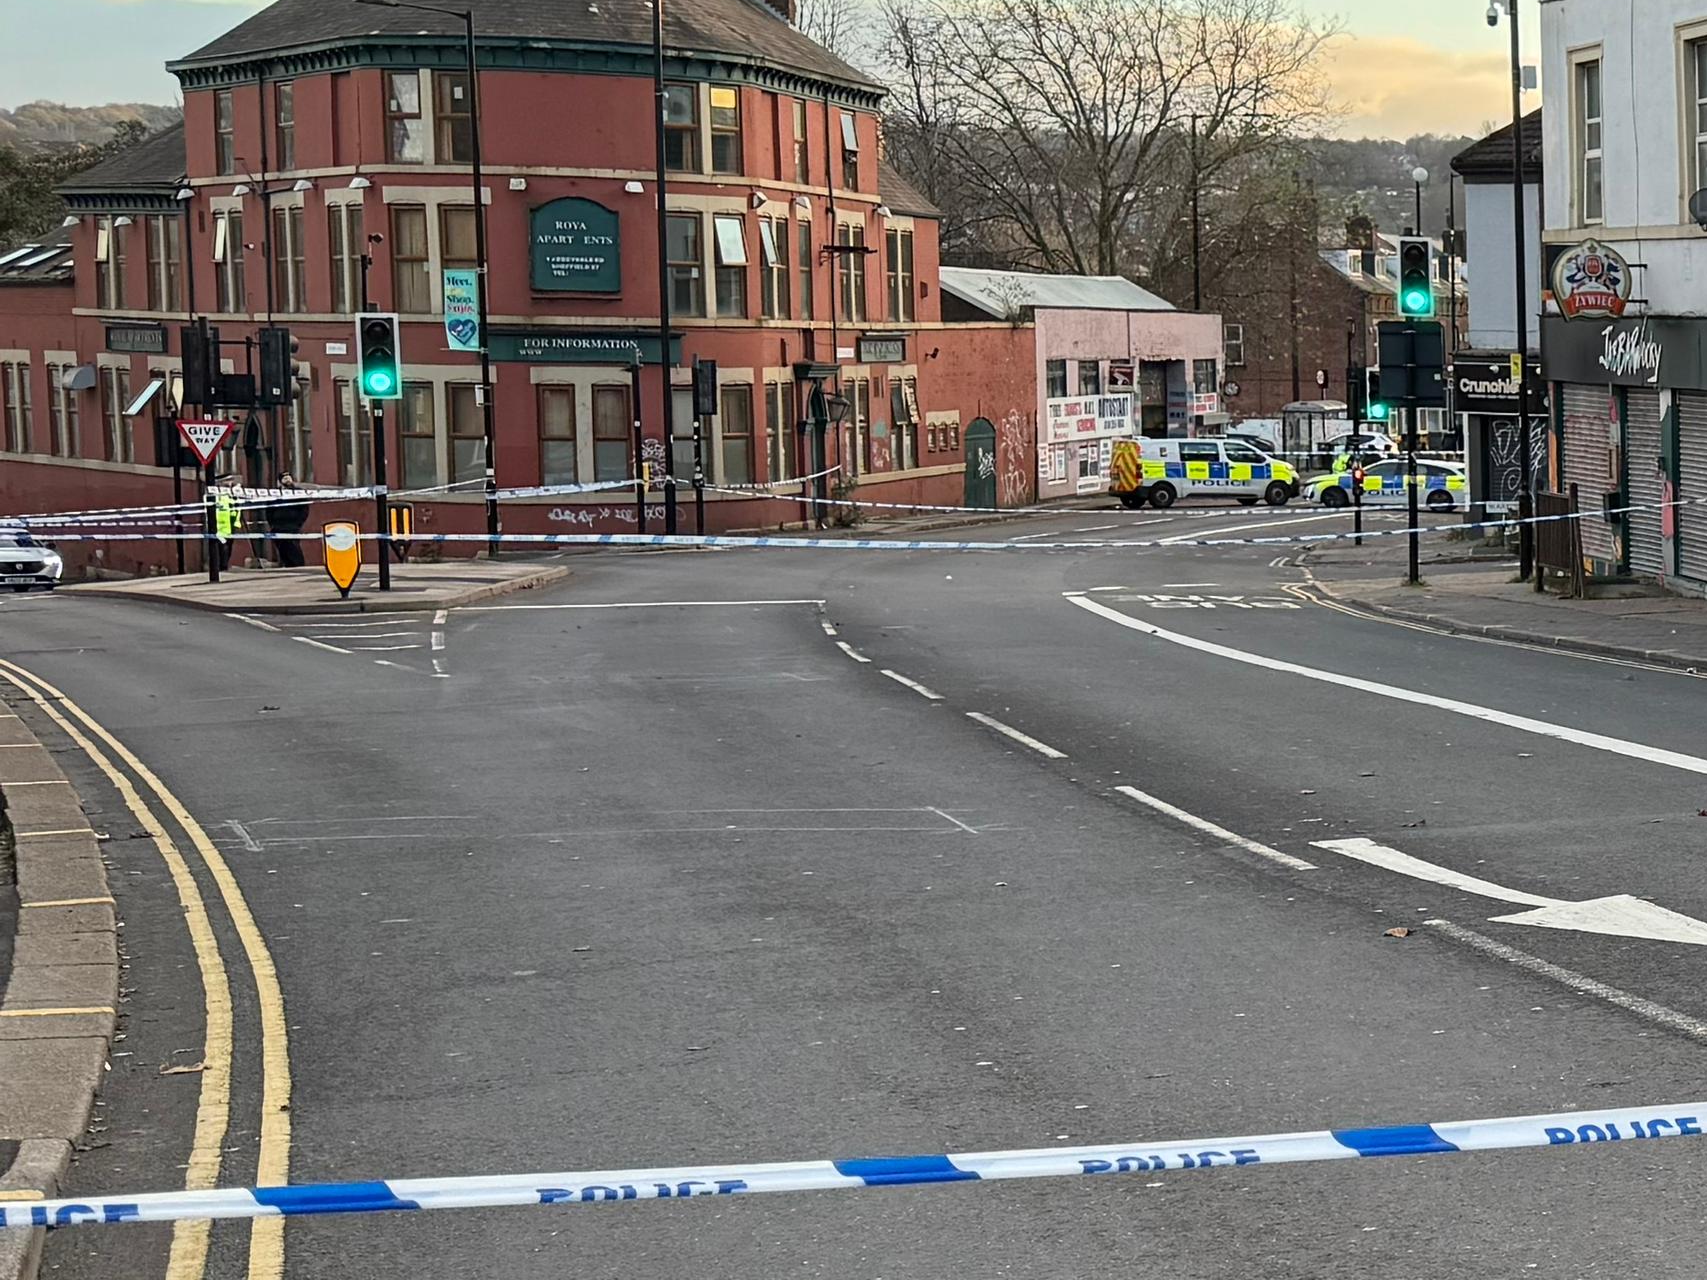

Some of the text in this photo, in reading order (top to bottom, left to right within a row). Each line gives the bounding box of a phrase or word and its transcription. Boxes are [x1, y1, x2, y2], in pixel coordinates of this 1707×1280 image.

[524, 338, 639, 349] FOR INFORMATION
[188, 426, 221, 436] GIVE
